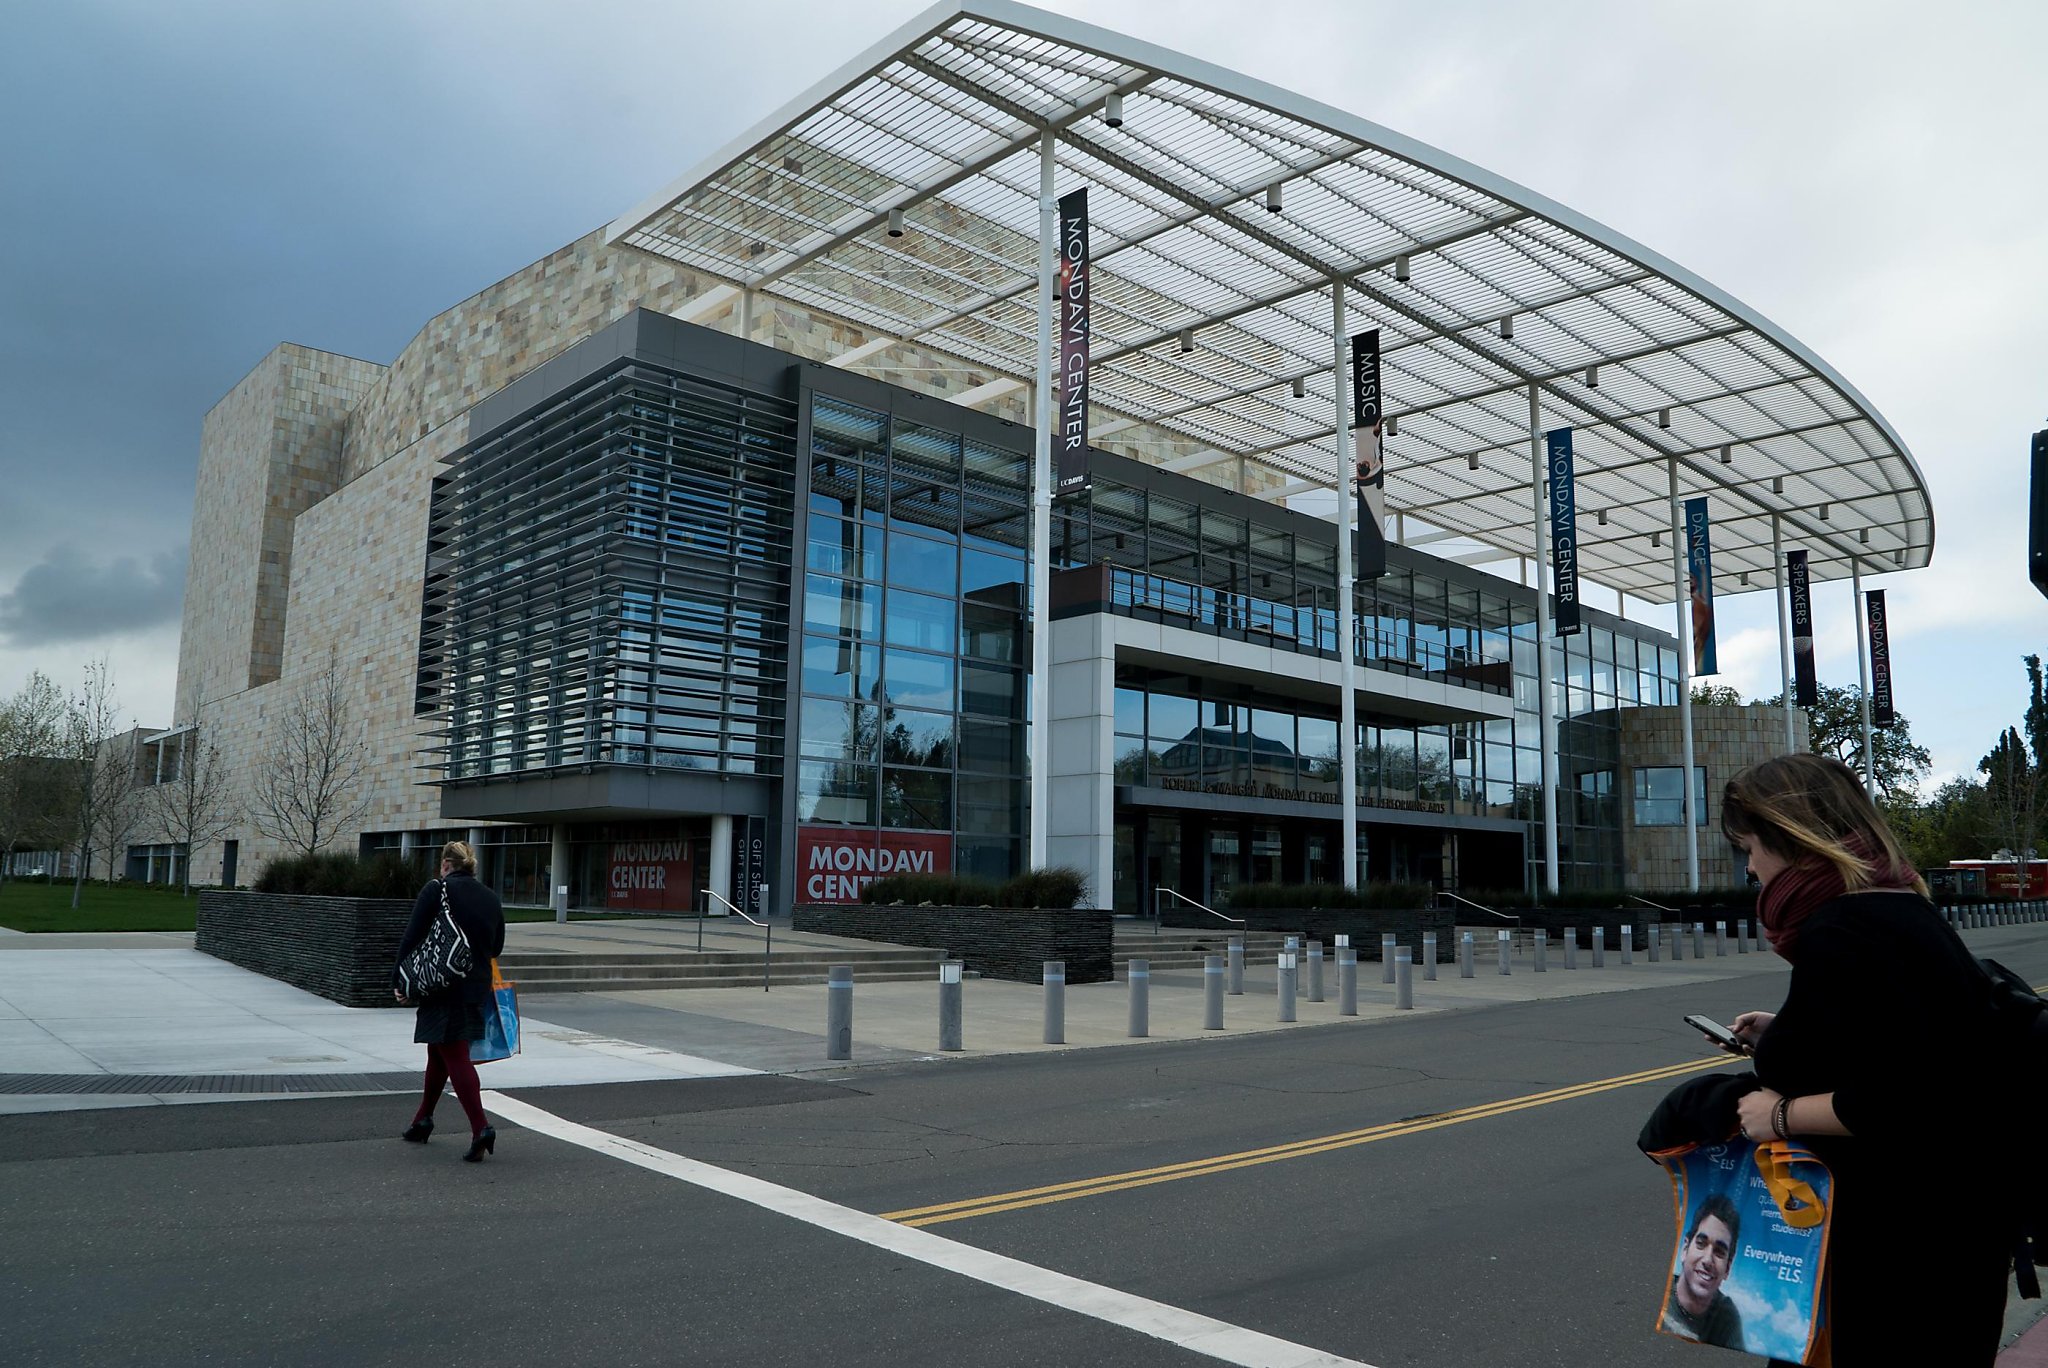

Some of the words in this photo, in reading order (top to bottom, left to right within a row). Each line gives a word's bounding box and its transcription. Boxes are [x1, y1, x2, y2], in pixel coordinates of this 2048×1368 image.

[1066, 217, 1084, 344] MONDAVI
[1066, 352, 1083, 452] CENTER
[1360, 353, 1377, 418] MUSIC
[1553, 446, 1571, 531] MONDAVI
[1691, 512, 1707, 567] DANCE
[1557, 537, 1573, 604] CENTER
[1792, 563, 1808, 625] SPEAKERS
[1870, 600, 1885, 660] MONDAVI
[1875, 663, 1889, 709] CENTER
[613, 840, 689, 862] MONDAVI
[752, 838, 763, 868] GIFT
[808, 845, 934, 874] MONDAVI
[611, 865, 666, 889] CENTER
[736, 872, 744, 908] SHOP
[751, 872, 762, 908] SHOP
[1720, 1158, 1736, 1171] ELS
[1771, 1223, 1813, 1238] students?
[1743, 1244, 1804, 1267] Everywhere
[1777, 1265, 1804, 1284] ELS.
